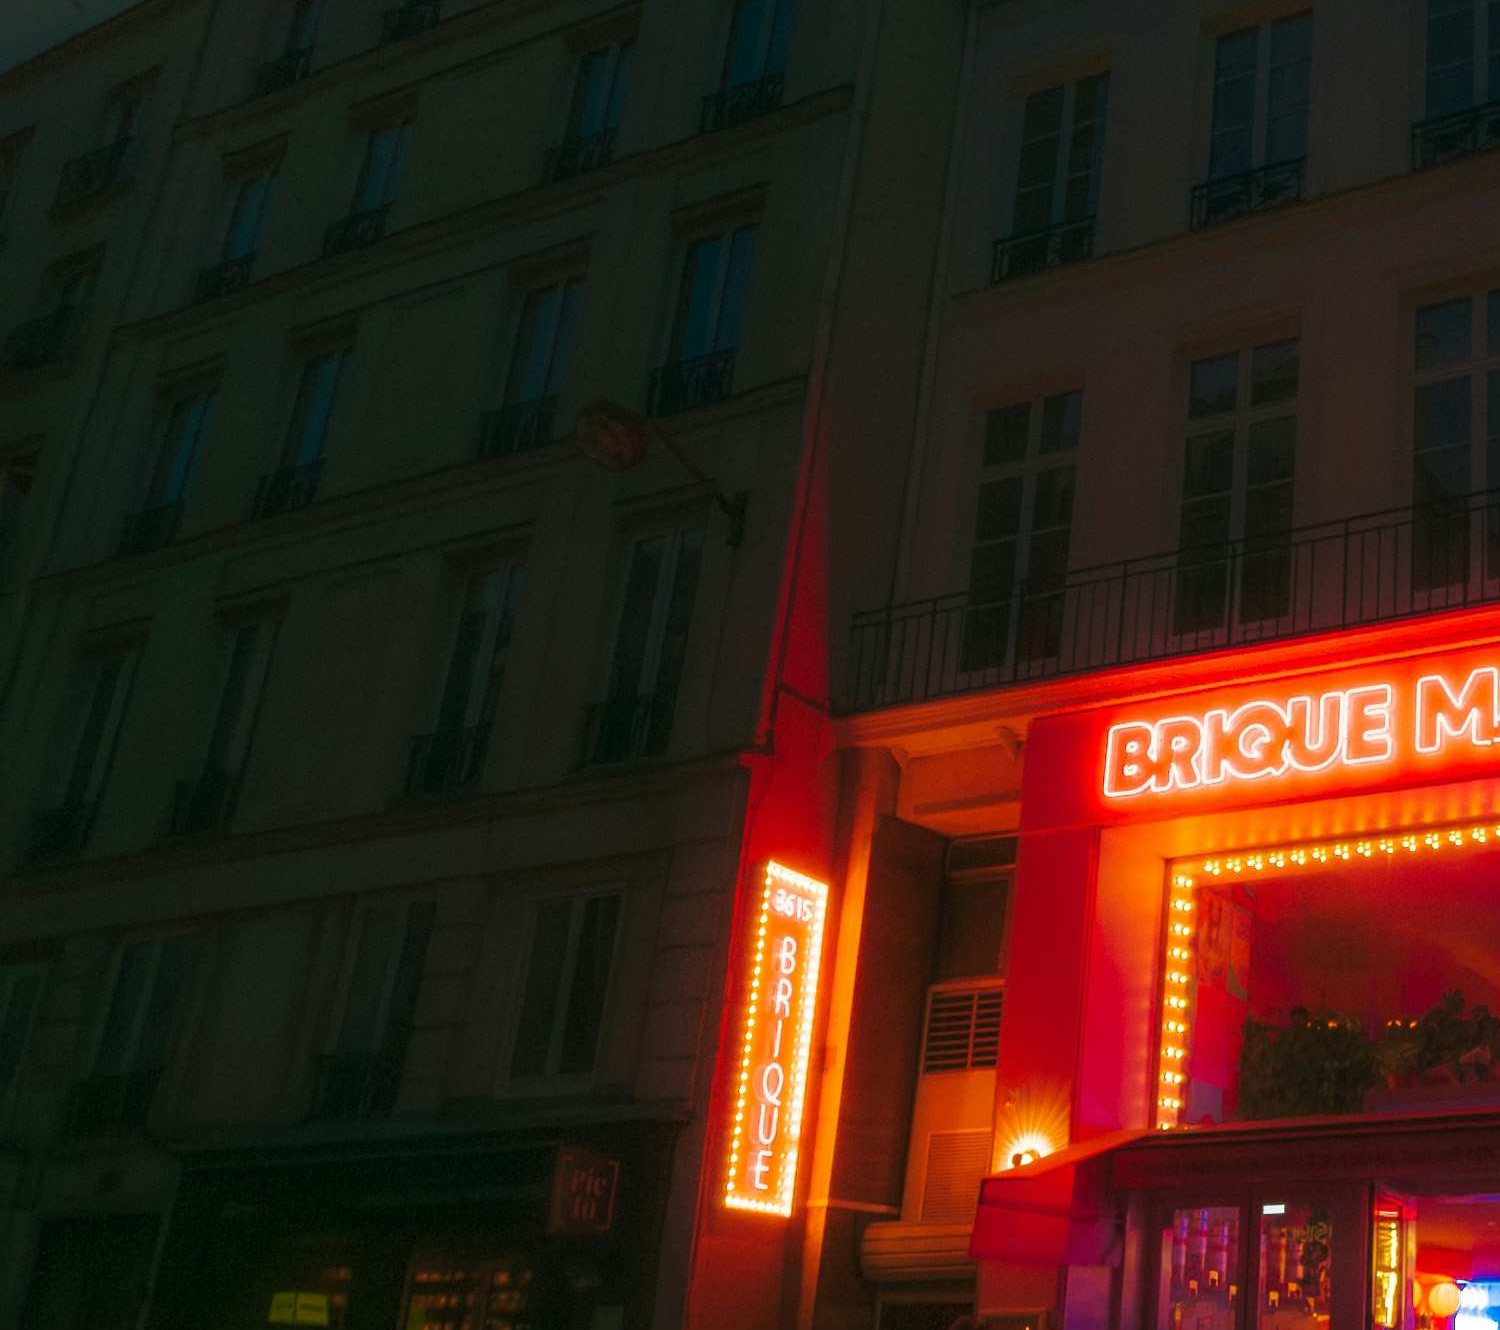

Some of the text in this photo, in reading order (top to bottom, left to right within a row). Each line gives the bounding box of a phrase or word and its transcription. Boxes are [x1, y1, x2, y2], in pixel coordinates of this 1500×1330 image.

[1103, 682, 1393, 798] BRIQUE
[774, 887, 812, 924] 3615
[754, 935, 797, 1191] BRIQUE
